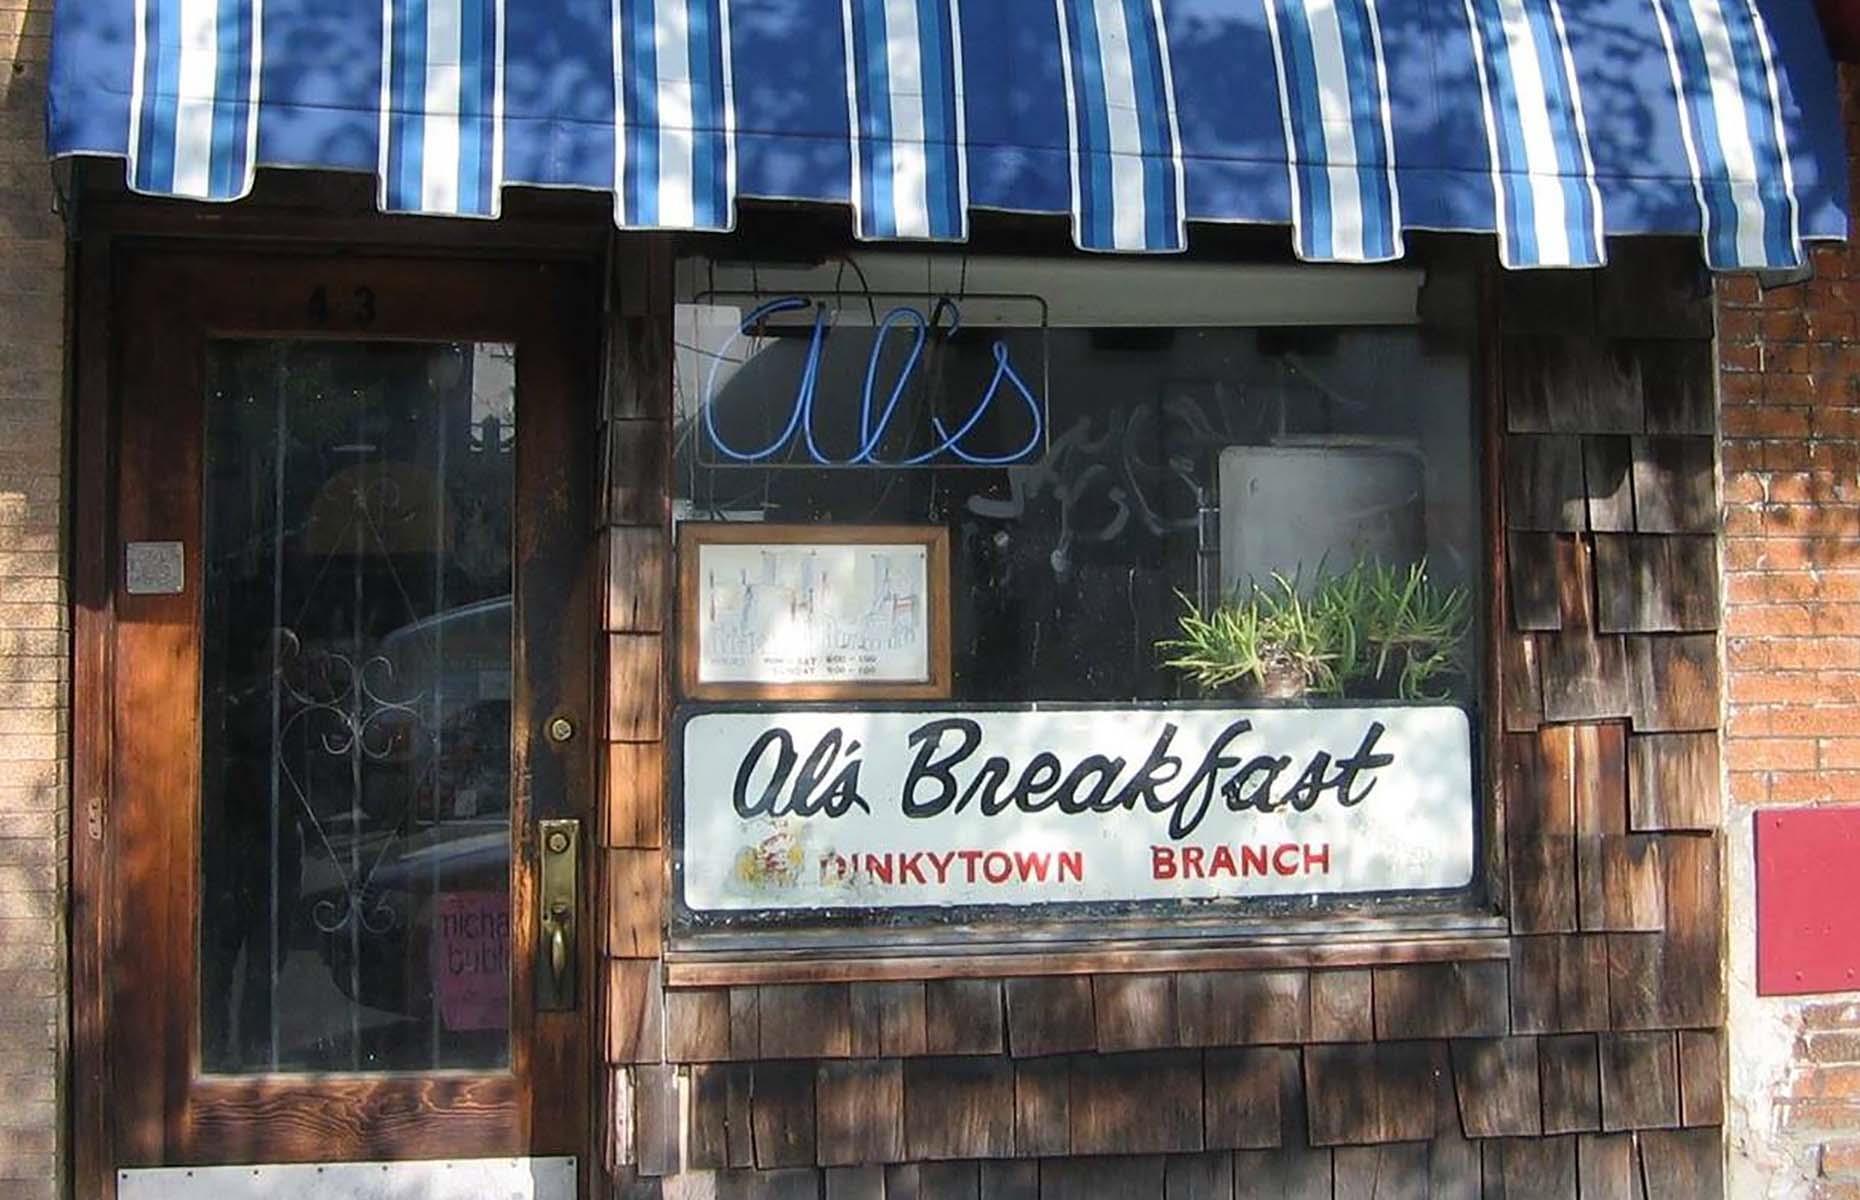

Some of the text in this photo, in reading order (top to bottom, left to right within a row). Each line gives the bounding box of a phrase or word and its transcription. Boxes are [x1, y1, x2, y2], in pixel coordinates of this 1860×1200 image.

[732, 717, 1394, 841] Al's Breakfast
[1151, 843, 1330, 880] BRANCH
